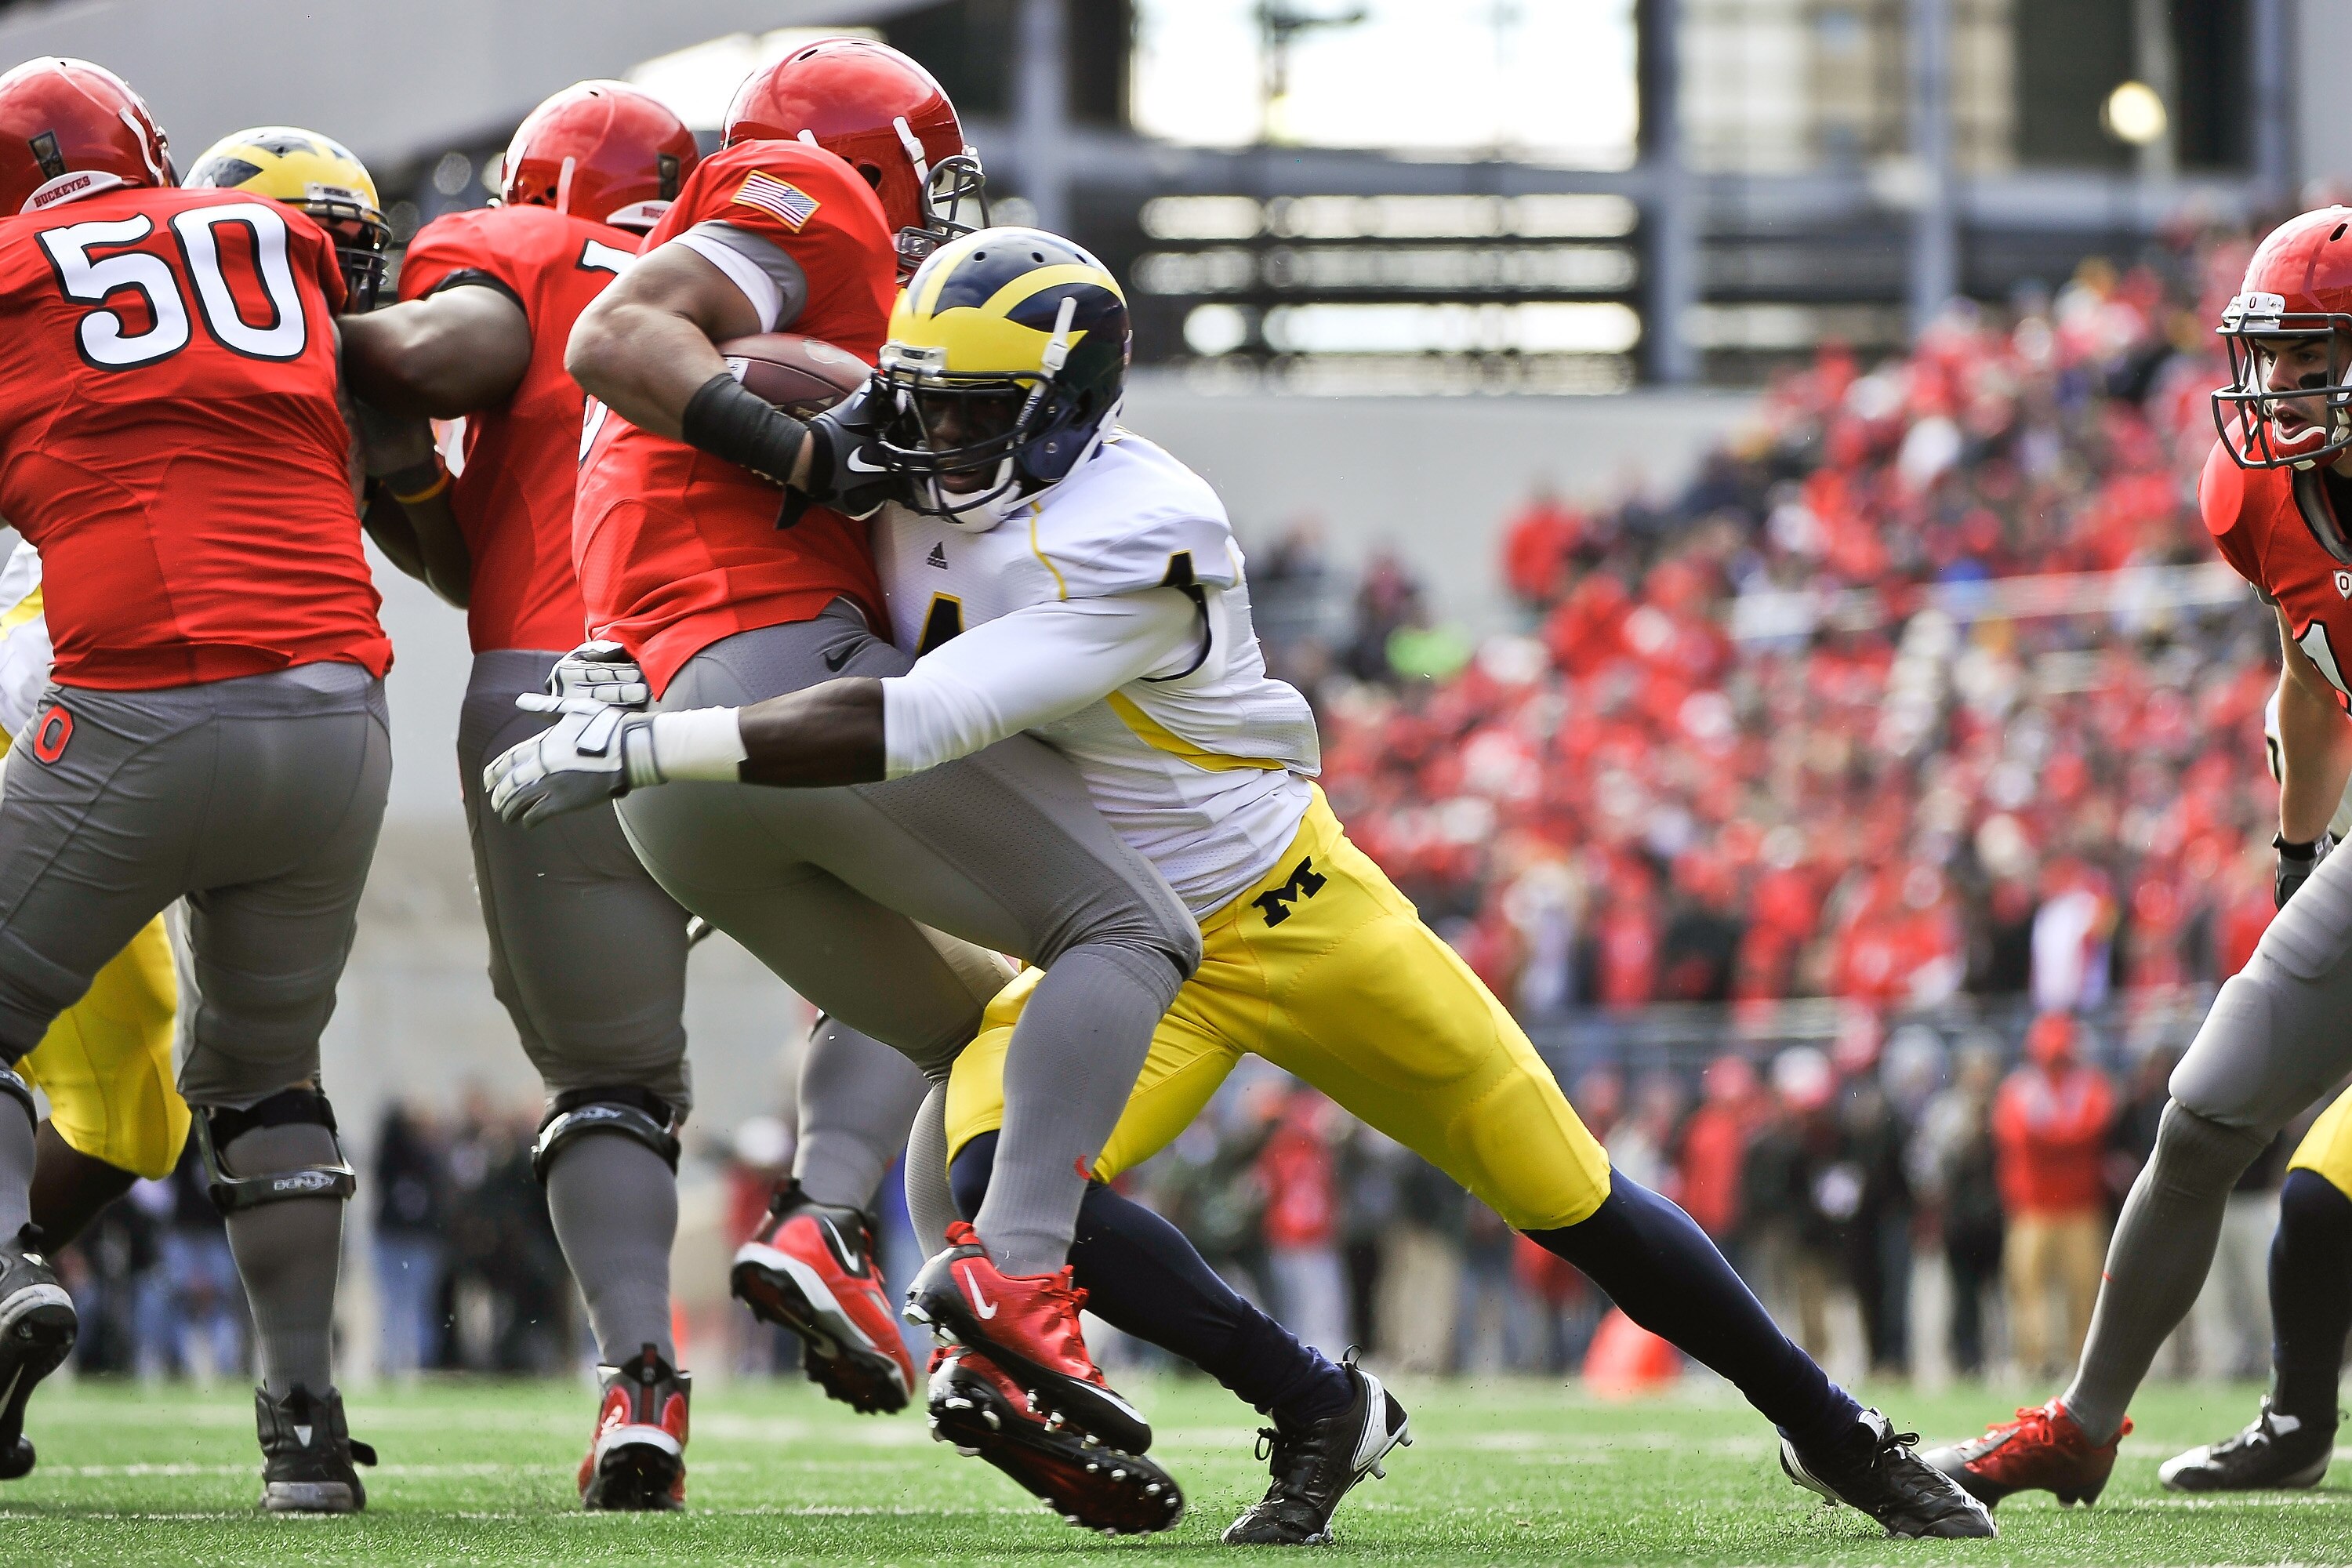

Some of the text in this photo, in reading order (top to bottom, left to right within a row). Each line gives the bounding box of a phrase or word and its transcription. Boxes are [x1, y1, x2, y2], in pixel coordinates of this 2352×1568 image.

[33, 175, 92, 208] BUCKEYES
[34, 202, 308, 372] 50
[1250, 855, 1328, 929] M
